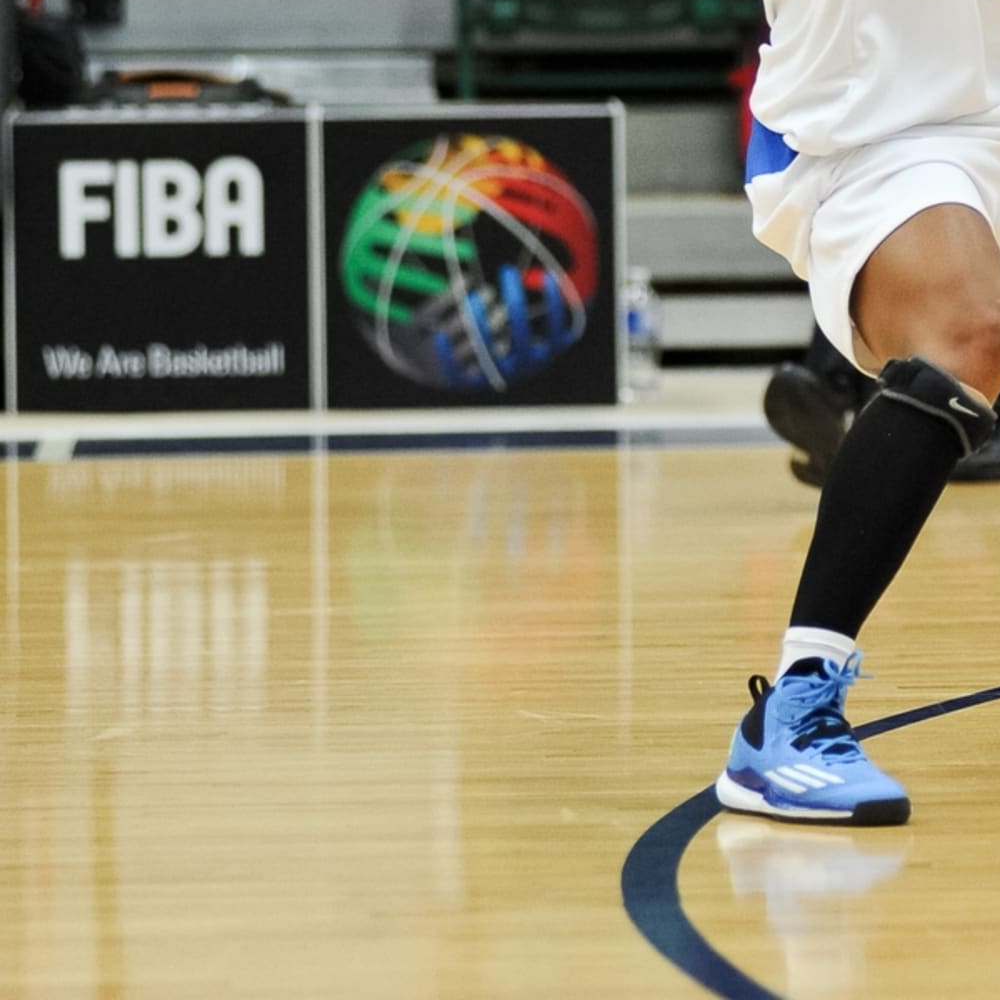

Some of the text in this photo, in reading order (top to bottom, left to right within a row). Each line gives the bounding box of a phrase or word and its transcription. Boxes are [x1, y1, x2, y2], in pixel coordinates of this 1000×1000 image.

[58, 156, 264, 260] FIBA
[43, 342, 285, 379] We Are Basketball
